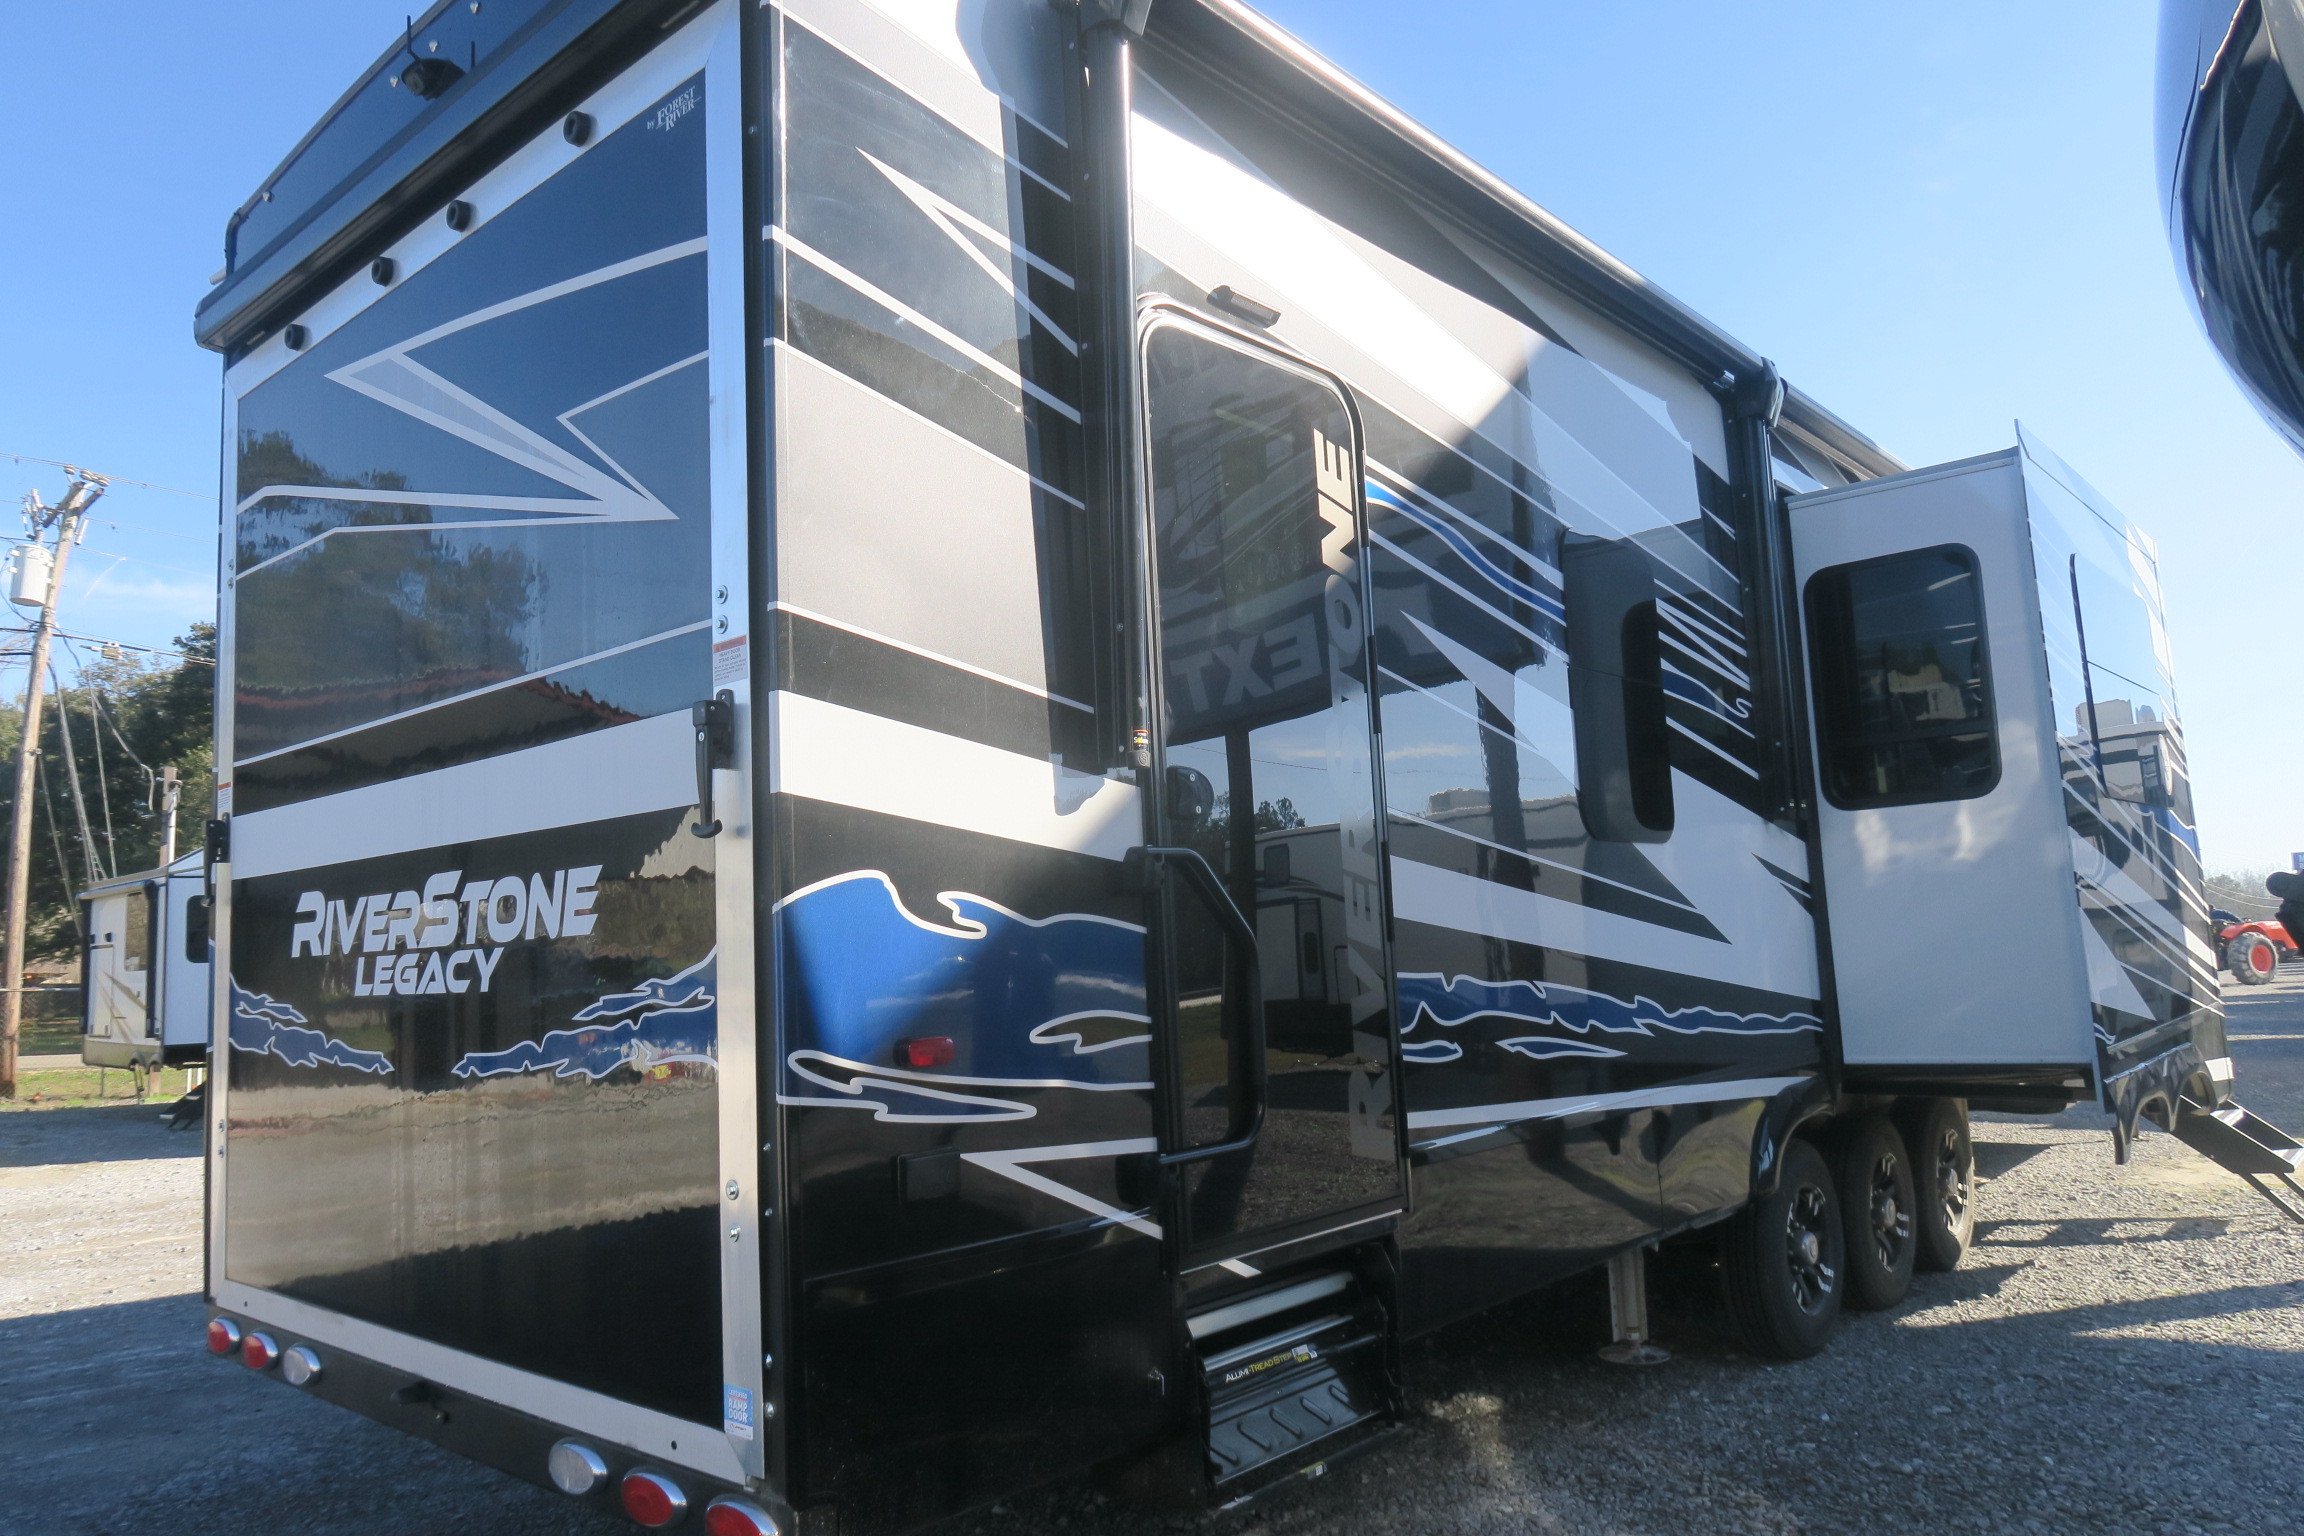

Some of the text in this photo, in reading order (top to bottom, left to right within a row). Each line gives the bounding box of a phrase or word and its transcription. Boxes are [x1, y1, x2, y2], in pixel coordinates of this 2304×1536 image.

[656, 86, 696, 126] FOREST
[665, 98, 695, 131] RIVER
[291, 864, 603, 958] RIVERSTONE
[354, 947, 504, 997] LEGACY
[728, 1398, 748, 1412] RAMP
[728, 1408, 749, 1423] DOOR
